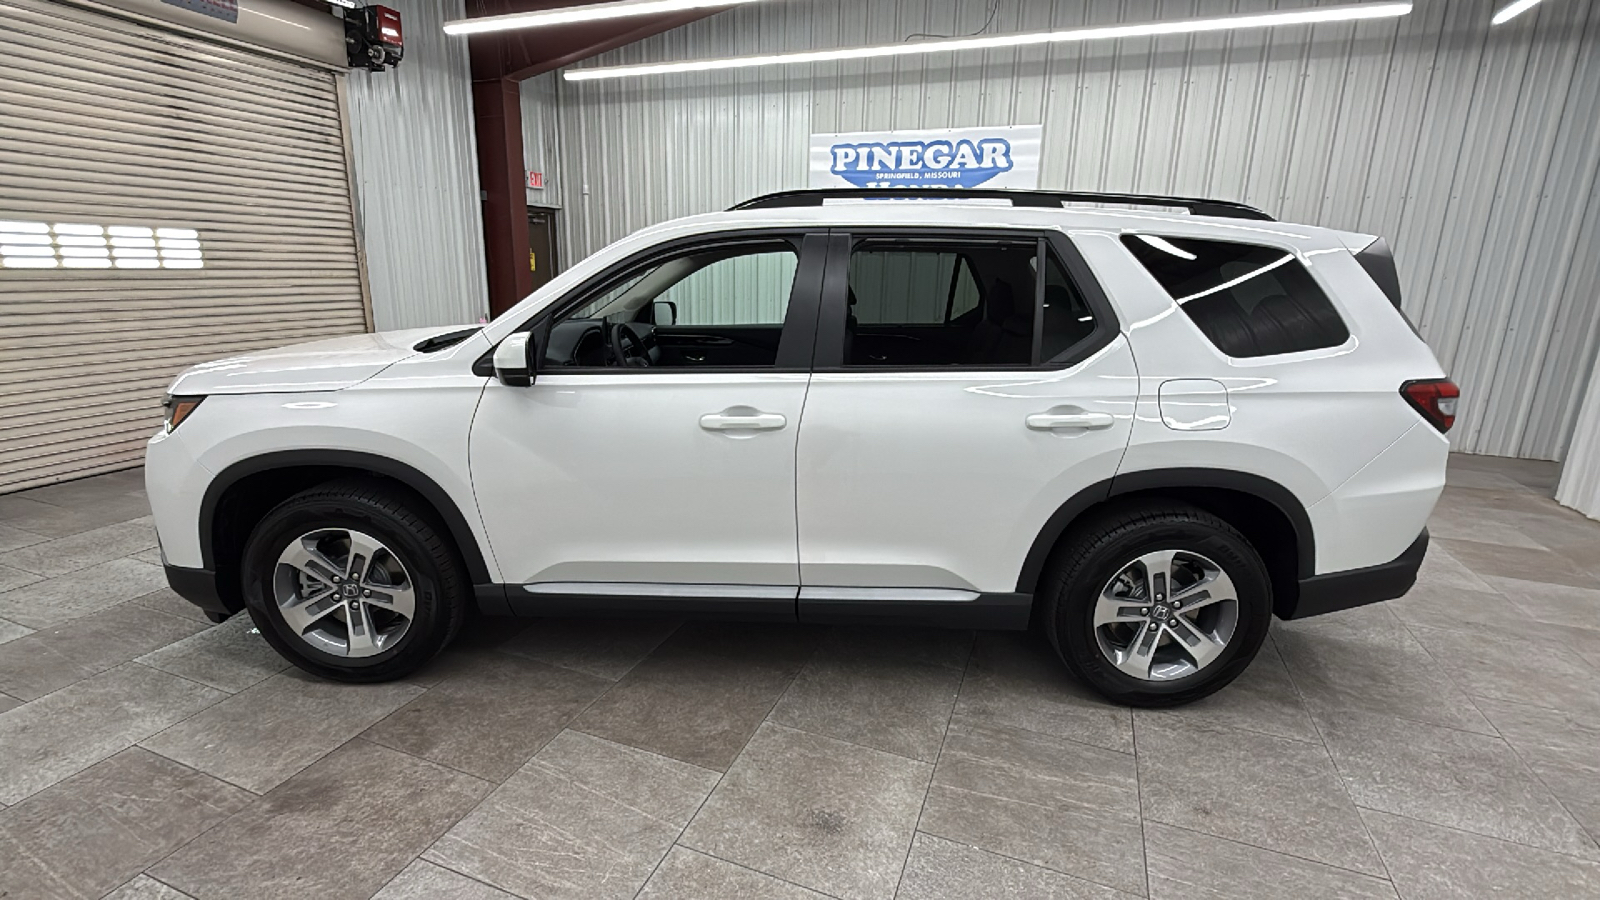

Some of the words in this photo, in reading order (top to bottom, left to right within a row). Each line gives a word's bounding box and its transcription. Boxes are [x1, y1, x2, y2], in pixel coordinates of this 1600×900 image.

[833, 142, 1009, 171] PINEGAR
[530, 171, 543, 187] EXIT
[876, 172, 922, 180] SPRINGFIELD,
[924, 171, 961, 179] MISSOURI
